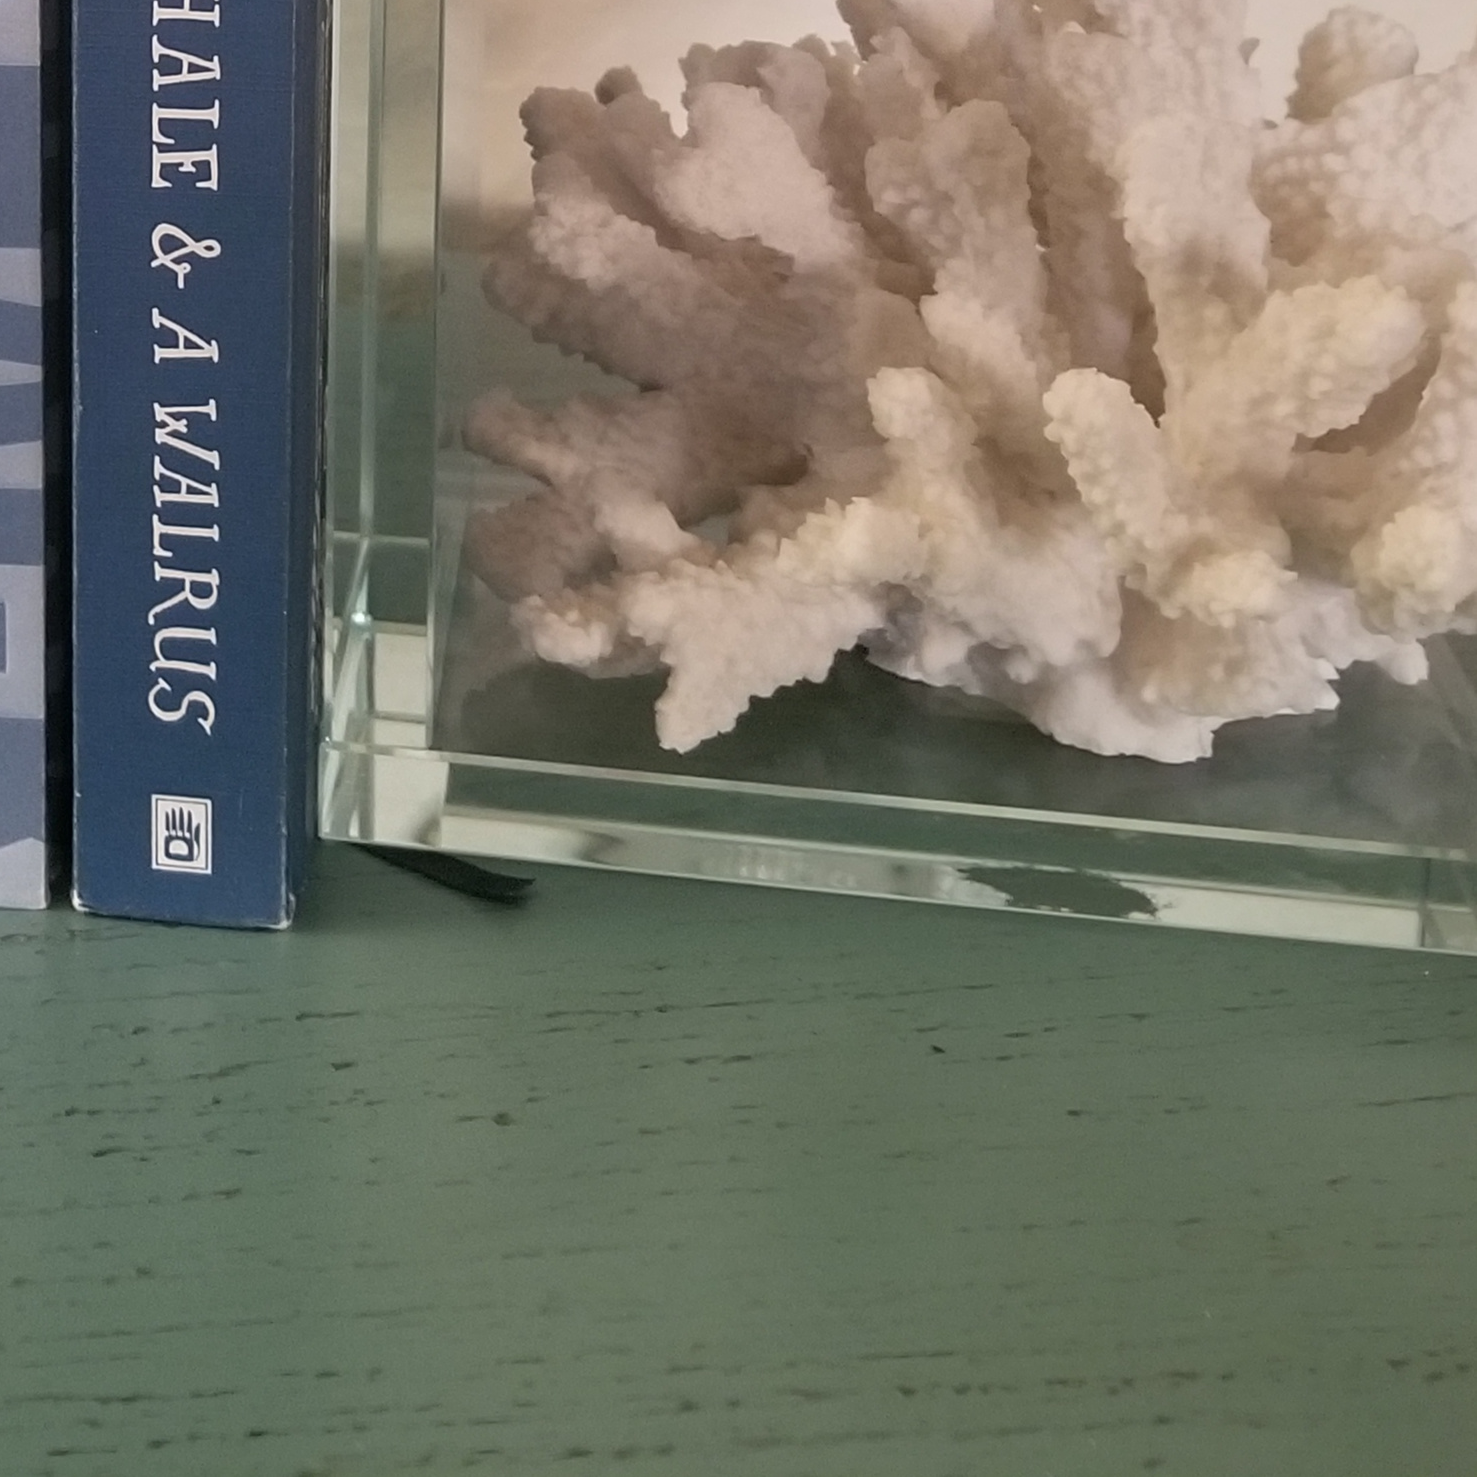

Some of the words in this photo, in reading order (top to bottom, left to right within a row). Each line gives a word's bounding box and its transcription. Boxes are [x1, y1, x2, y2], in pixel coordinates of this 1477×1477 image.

[150, 222, 222, 289] &
[152, 307, 220, 365] A
[147, 397, 221, 736] WALRUS
